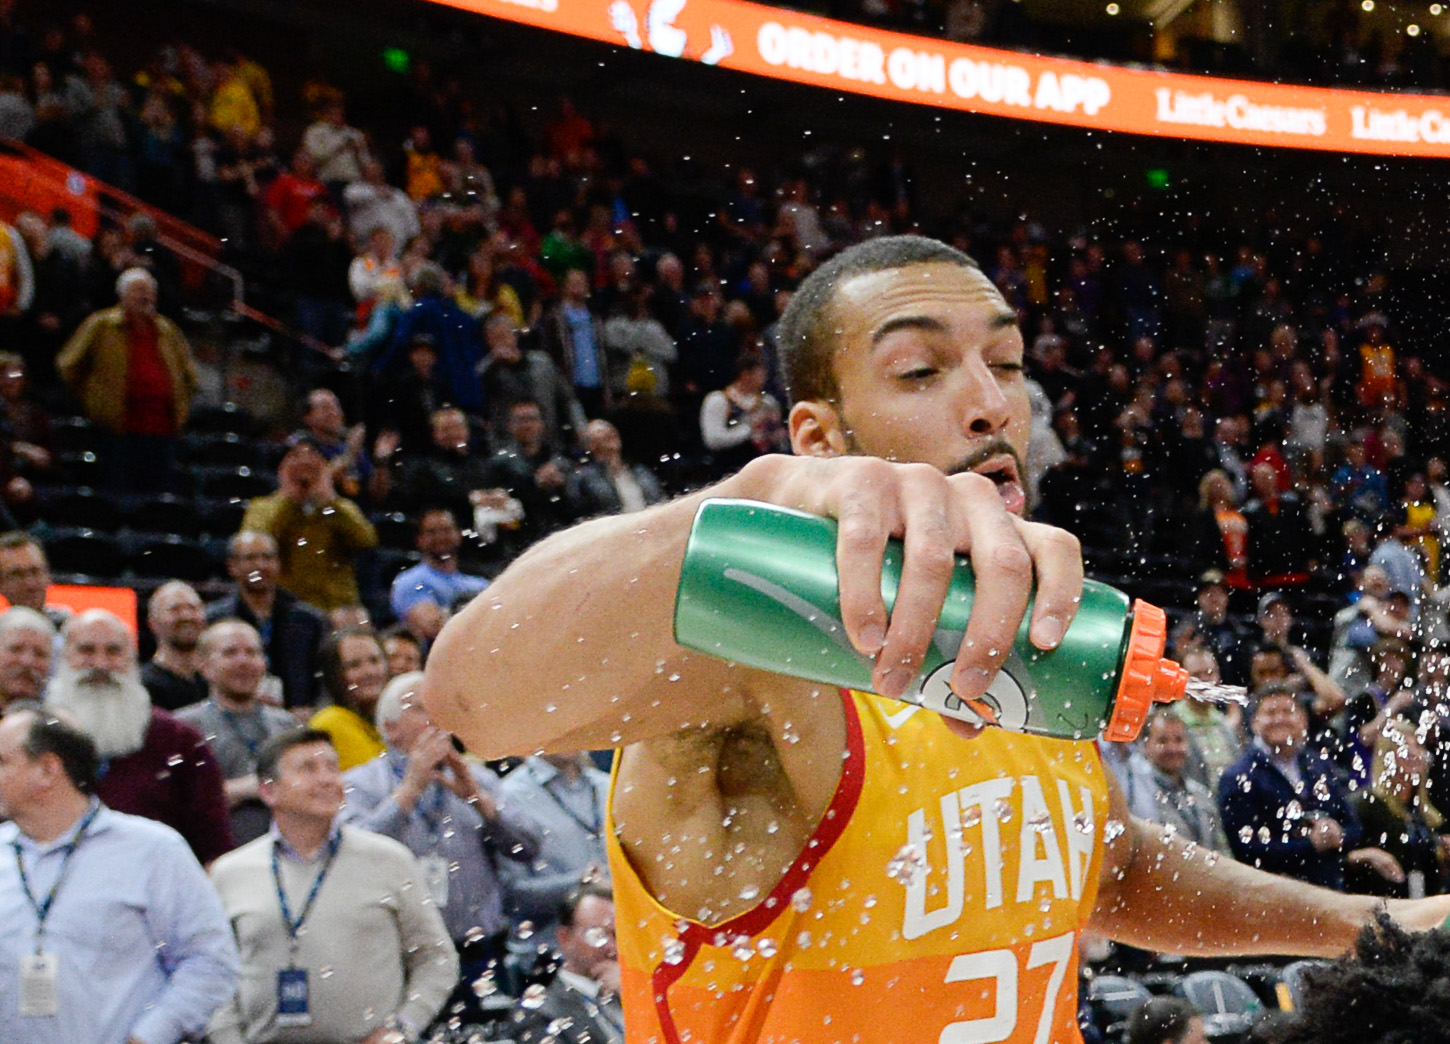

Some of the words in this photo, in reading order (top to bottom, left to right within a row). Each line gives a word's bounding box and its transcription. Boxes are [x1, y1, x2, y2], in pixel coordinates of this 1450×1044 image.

[757, 21, 886, 84] ORDER
[887, 47, 946, 93] ON
[948, 57, 1032, 107] OUR
[1033, 70, 1112, 116] APP
[902, 775, 1094, 940] UTAH
